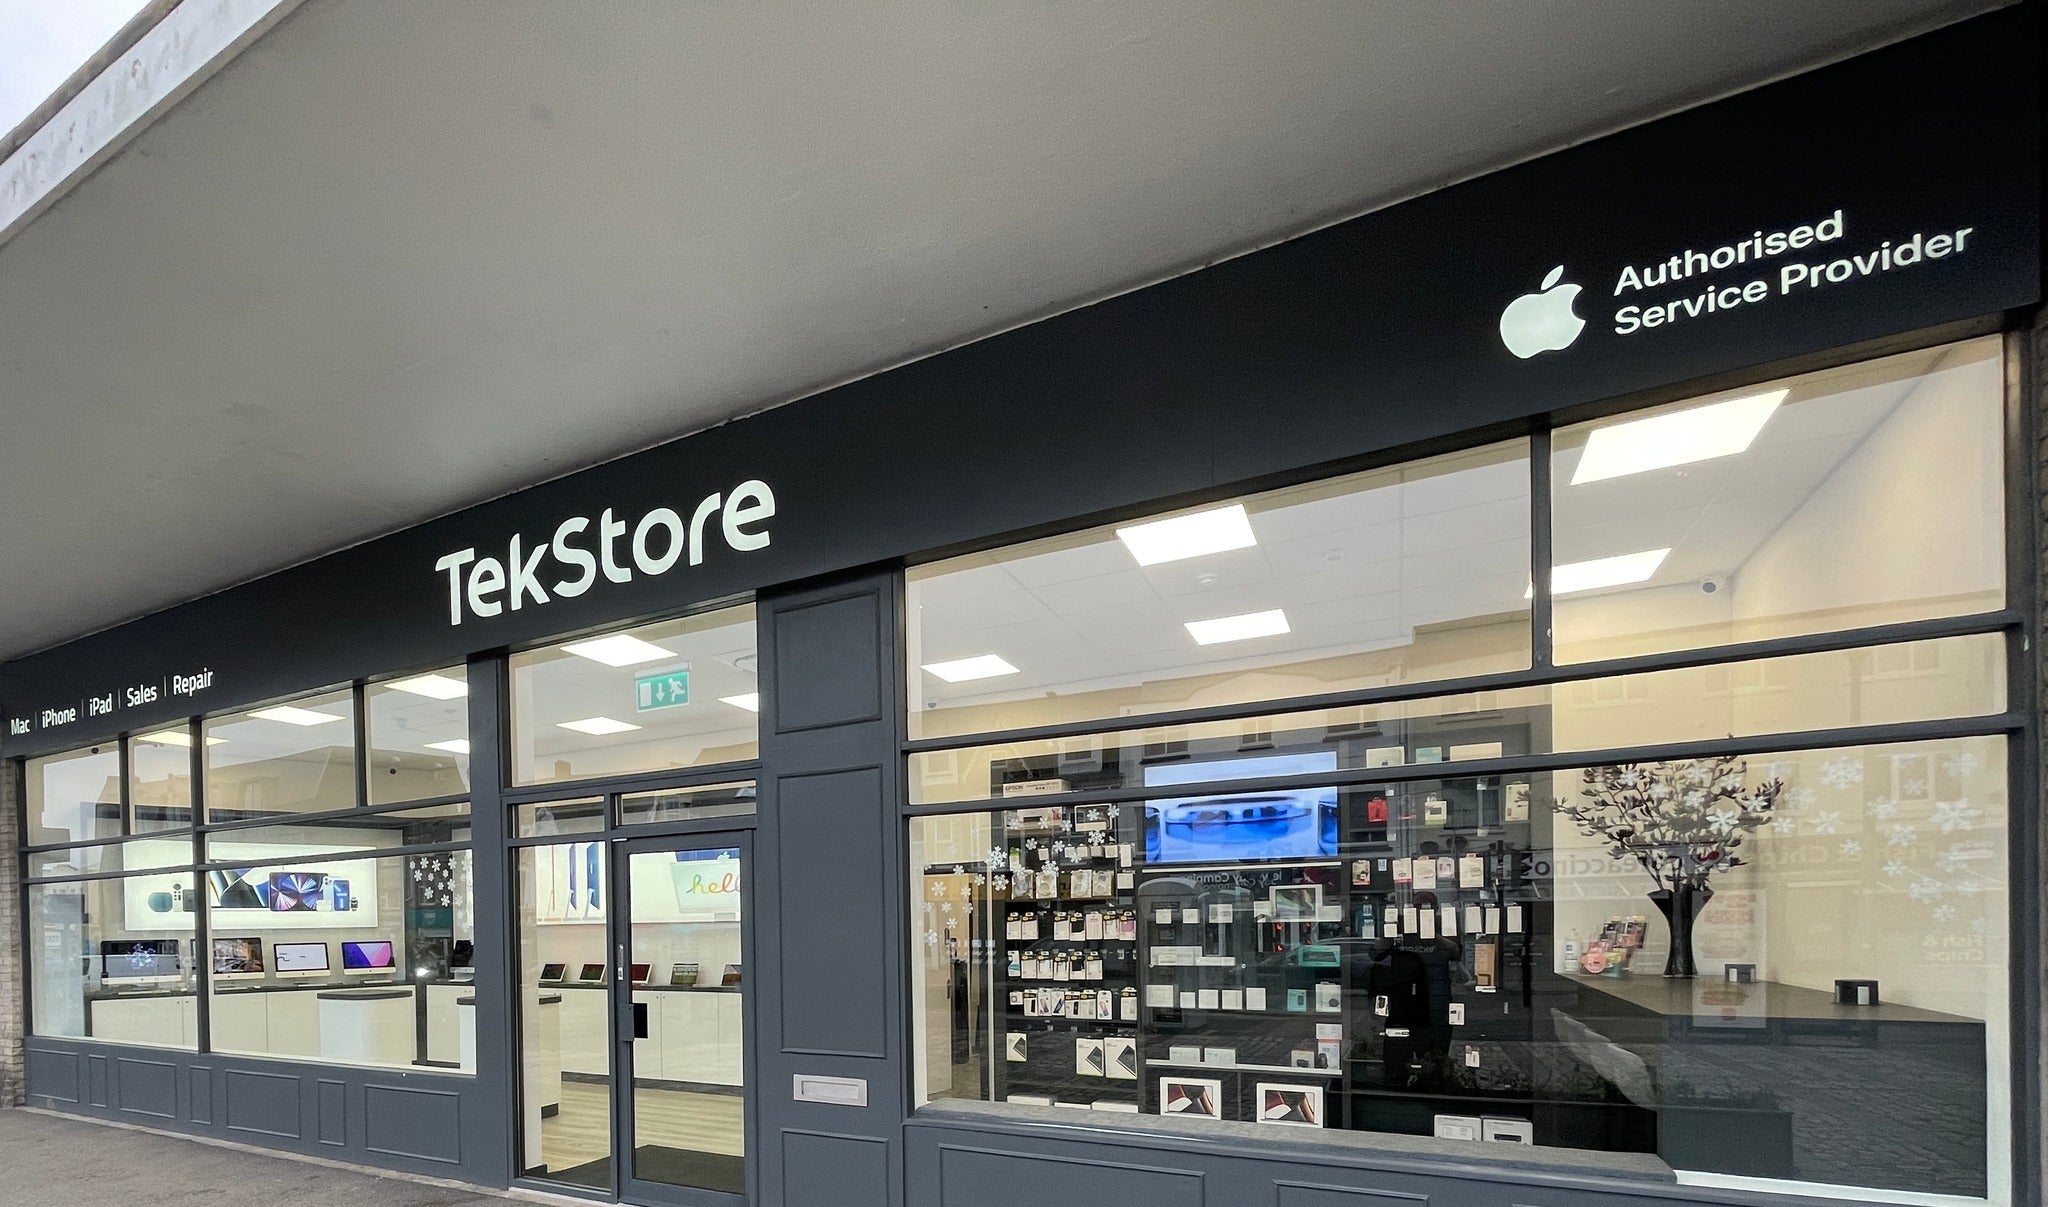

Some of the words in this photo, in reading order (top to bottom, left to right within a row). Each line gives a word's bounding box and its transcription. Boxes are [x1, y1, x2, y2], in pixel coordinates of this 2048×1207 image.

[1613, 209, 1844, 297] Authorised
[1614, 279, 1768, 336] Service
[1780, 227, 1974, 295] Provider
[435, 479, 776, 626] TekStore
[11, 717, 30, 736] Mac
[41, 707, 76, 729] iPhone
[89, 693, 113, 717] iPad
[126, 683, 158, 708] Sales
[173, 667, 214, 697] Repair
